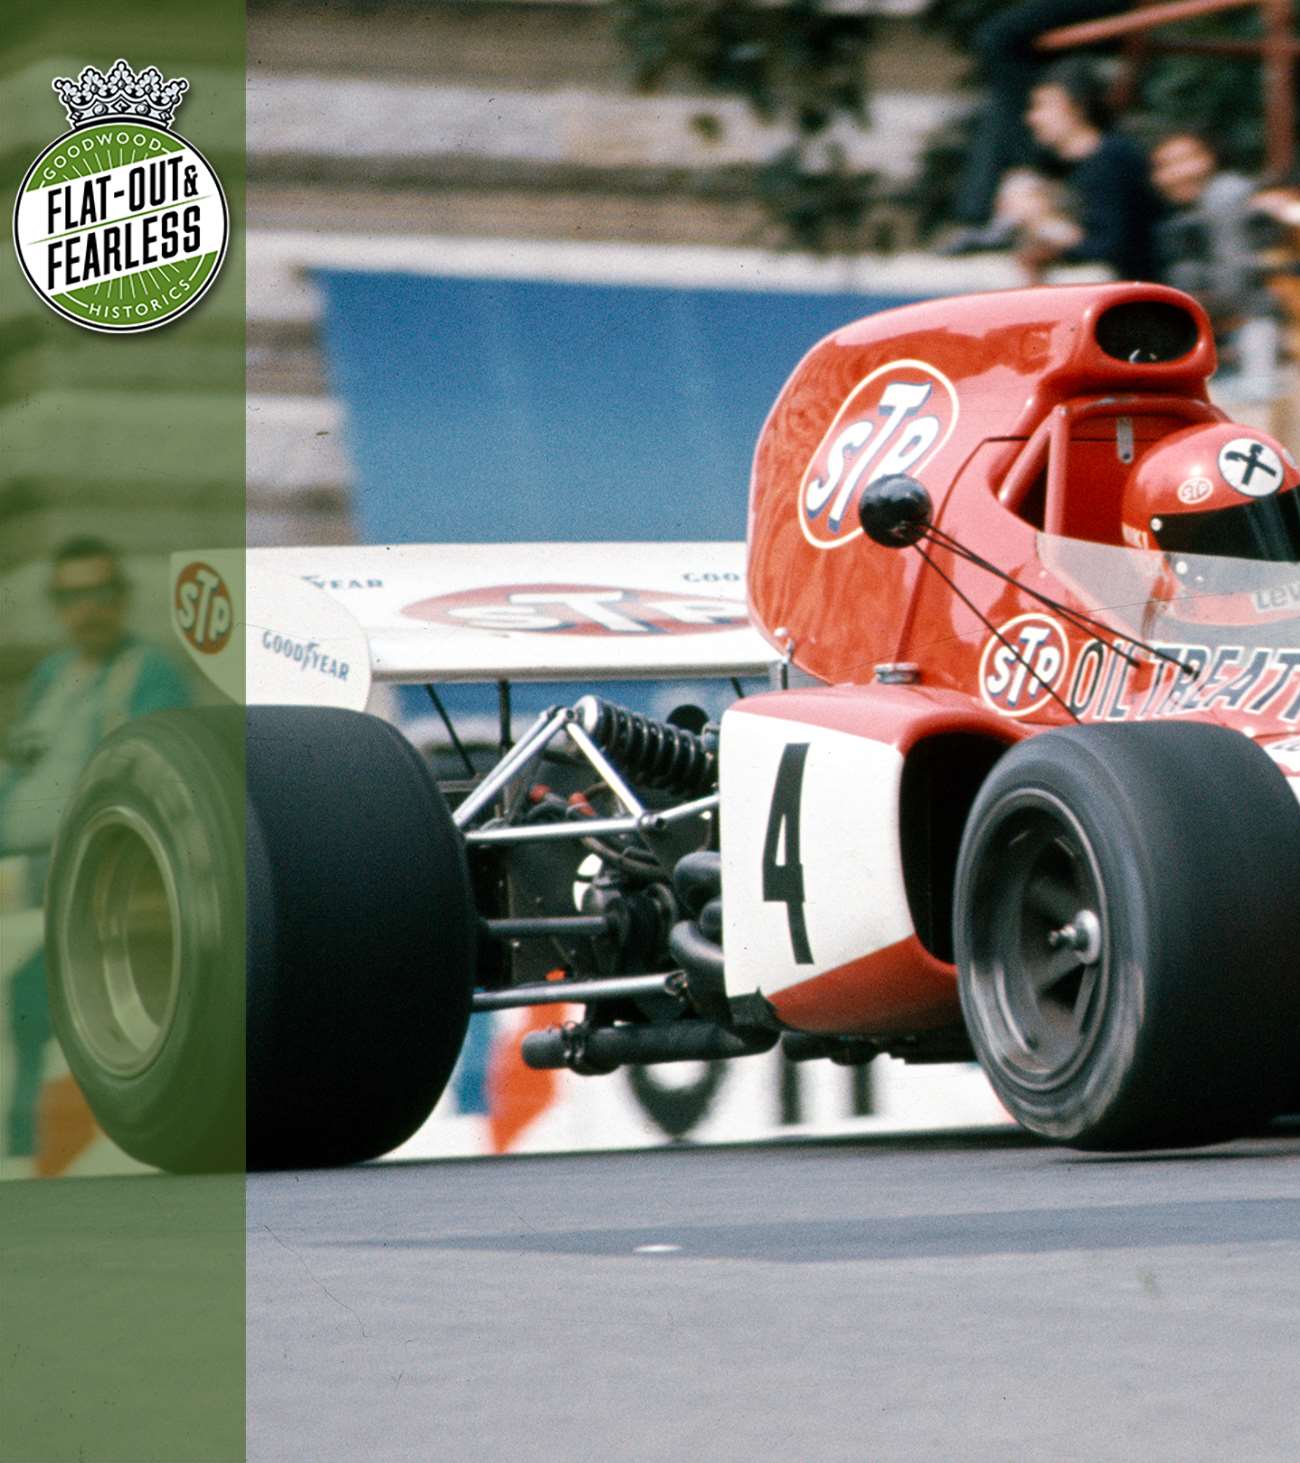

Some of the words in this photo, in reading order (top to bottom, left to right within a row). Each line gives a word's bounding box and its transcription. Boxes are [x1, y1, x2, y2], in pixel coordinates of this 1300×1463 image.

[806, 381, 939, 533] STP
[176, 567, 232, 647] STP
[448, 592, 749, 634] STP
[262, 629, 350, 681] GOODYEAR
[985, 626, 1063, 706] STP
[1067, 638, 1140, 721] OIL
[762, 742, 815, 965] 4
